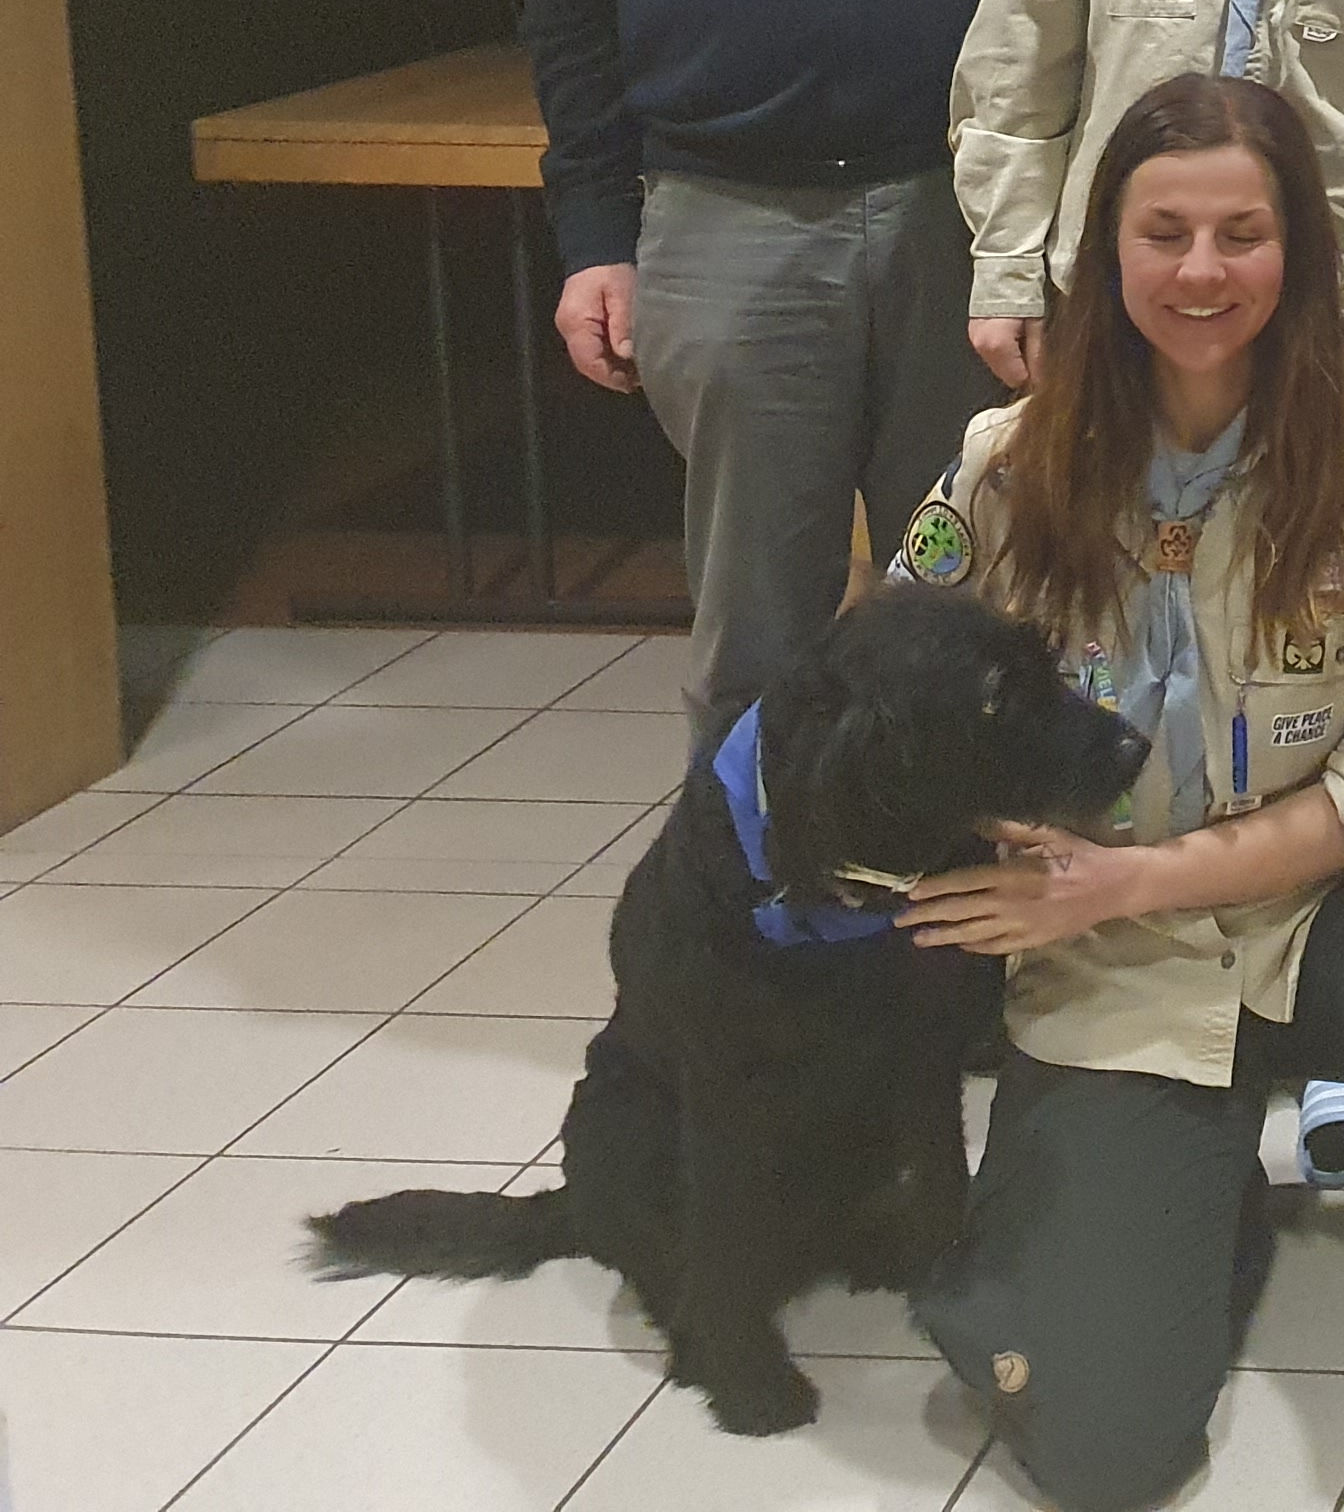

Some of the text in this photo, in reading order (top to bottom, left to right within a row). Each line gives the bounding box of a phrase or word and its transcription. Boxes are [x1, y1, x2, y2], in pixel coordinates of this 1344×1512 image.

[1272, 706, 1333, 732] GIVE PEACE
[1273, 724, 1327, 744] A CHANCE
